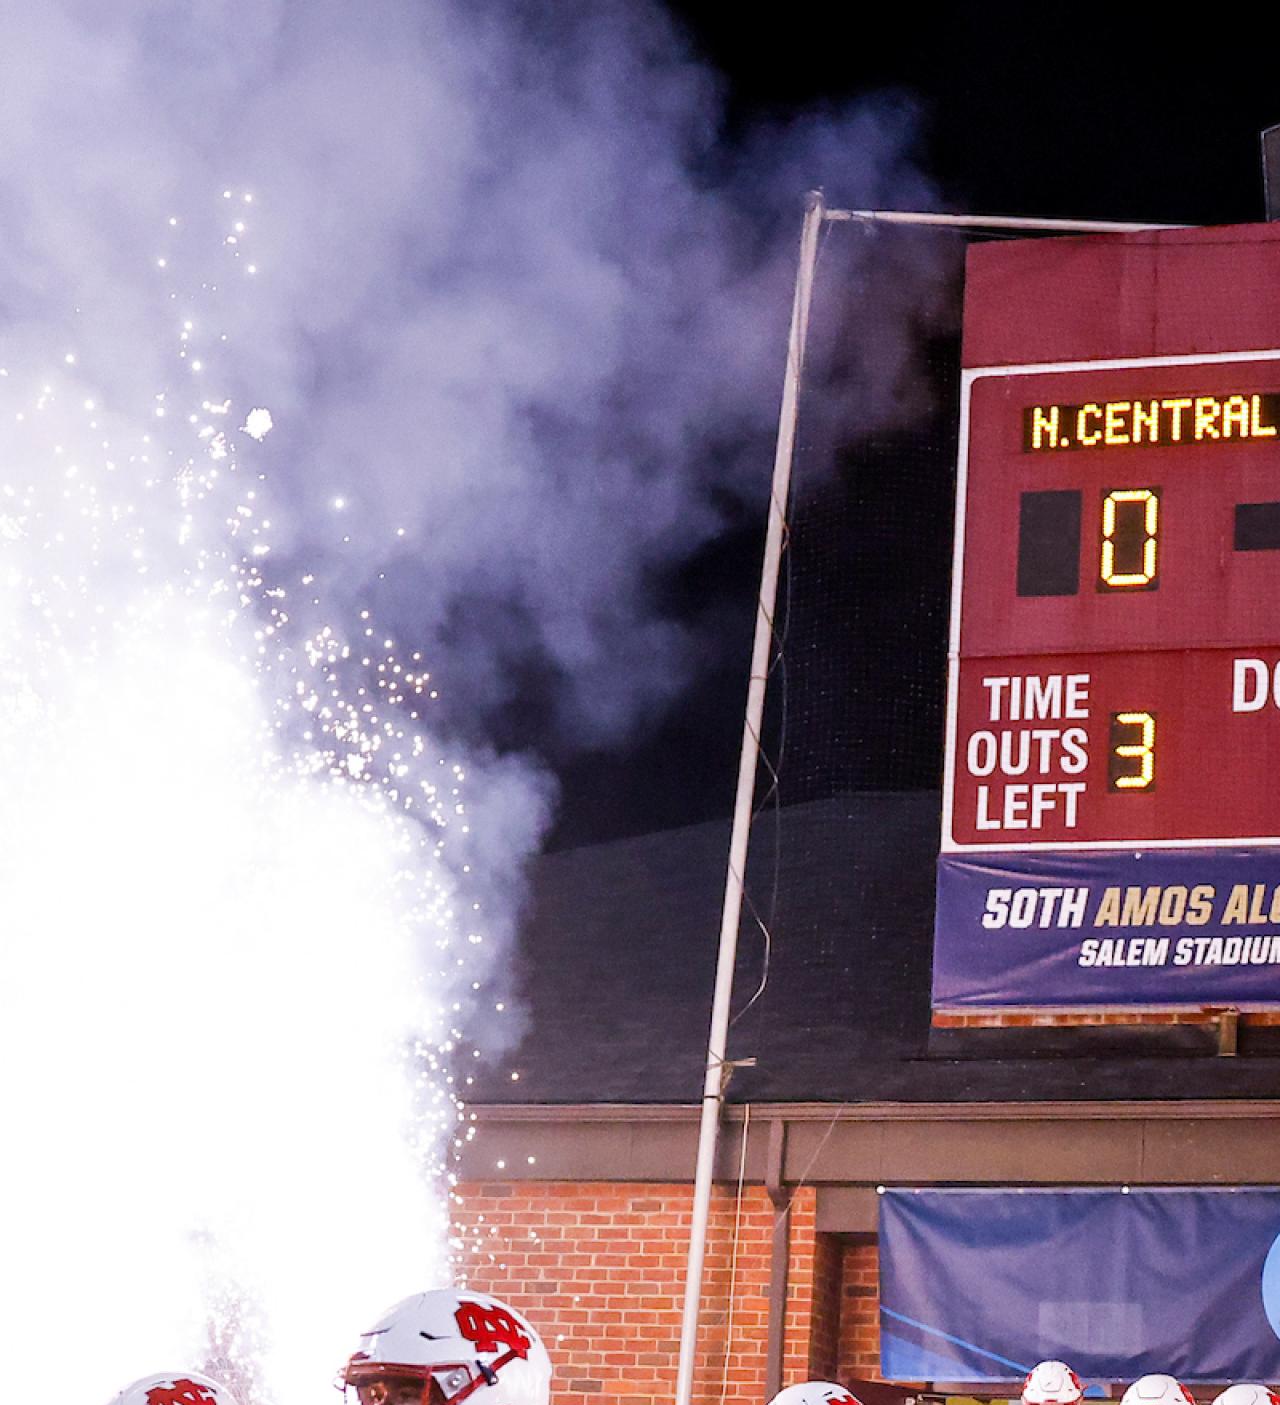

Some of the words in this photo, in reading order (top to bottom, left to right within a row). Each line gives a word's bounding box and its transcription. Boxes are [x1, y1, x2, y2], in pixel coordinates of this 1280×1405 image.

[1032, 395, 1276, 450] N.CENTRAL
[1101, 488, 1158, 586] 0
[982, 674, 1091, 722] TIME
[965, 728, 1089, 778] OUTS
[1115, 712, 1155, 789] 3
[975, 782, 1086, 831] LEFT
[982, 887, 1087, 930] 50TH
[1094, 884, 1213, 927] AMOS
[1079, 936, 1168, 967] SALEM
